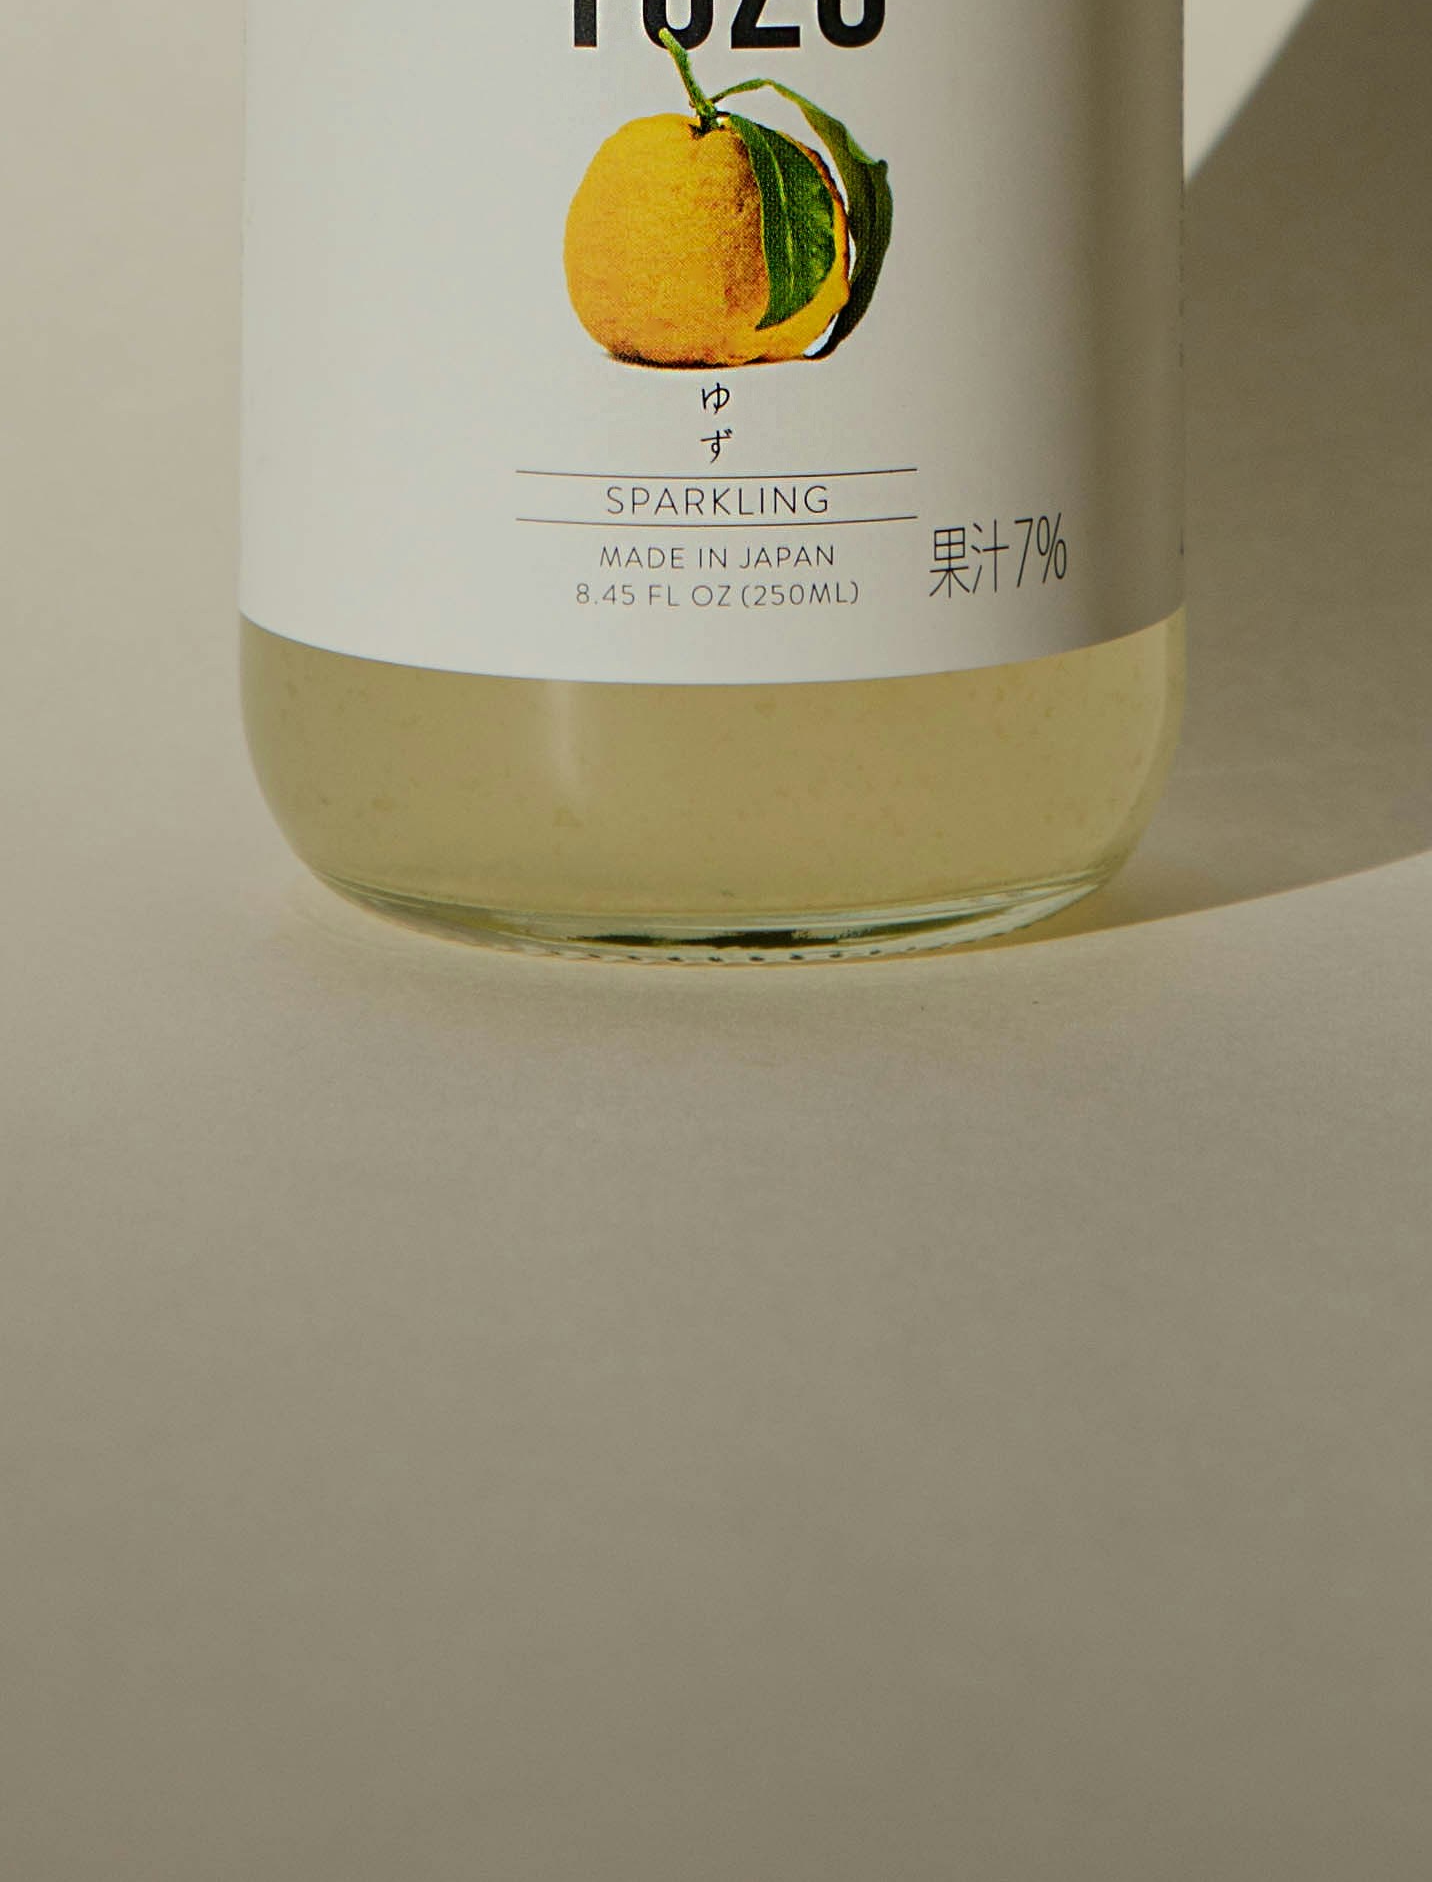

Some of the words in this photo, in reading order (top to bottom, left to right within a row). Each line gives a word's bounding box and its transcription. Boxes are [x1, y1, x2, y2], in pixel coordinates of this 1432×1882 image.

[700, 381, 733, 465] ゆず
[606, 484, 828, 516] SPARKLING
[599, 545, 685, 569] MADE
[698, 547, 727, 569] IN
[739, 544, 835, 569] JAPAN
[575, 583, 636, 606] 8.45
[648, 585, 680, 607] FL
[691, 585, 732, 607] OZ
[741, 580, 859, 608] (250ML)
